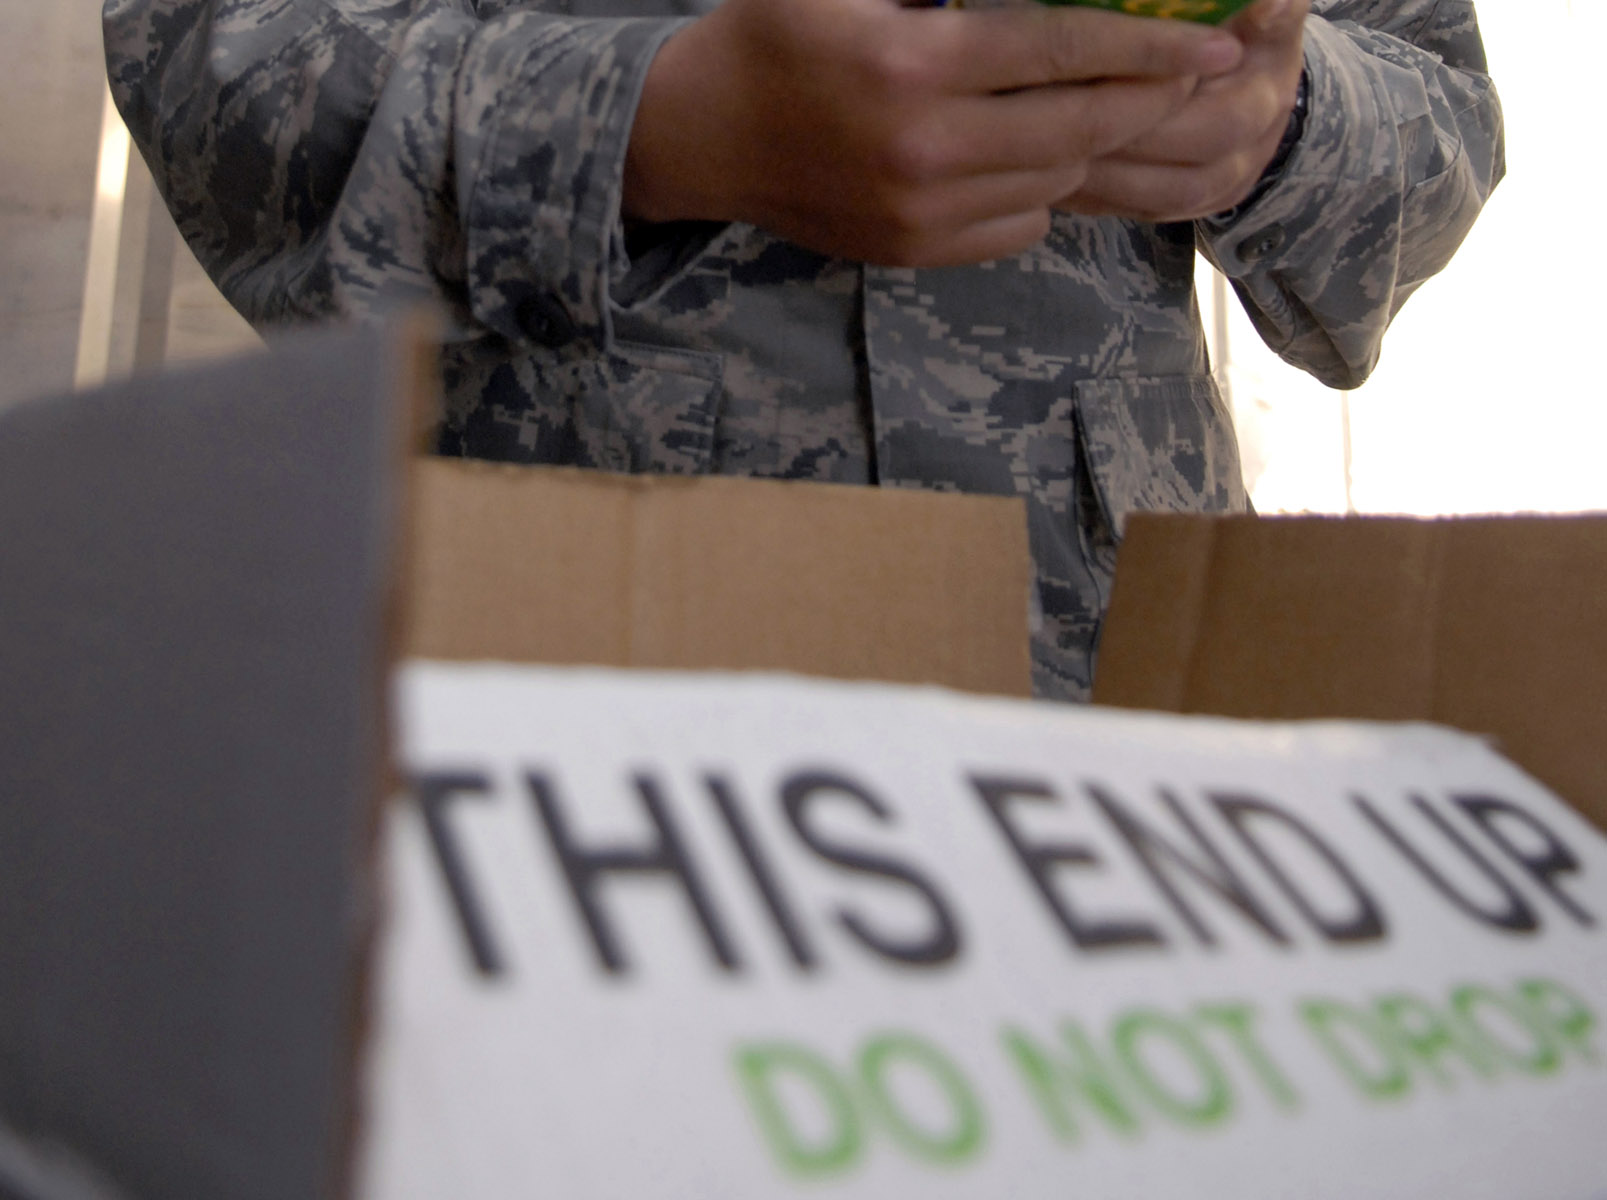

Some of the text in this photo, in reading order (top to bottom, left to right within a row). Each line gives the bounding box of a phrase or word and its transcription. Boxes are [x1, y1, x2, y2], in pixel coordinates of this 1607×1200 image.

[402, 766, 1598, 978] THIS END UP
[735, 980, 1598, 1175] DO NOT DROP
